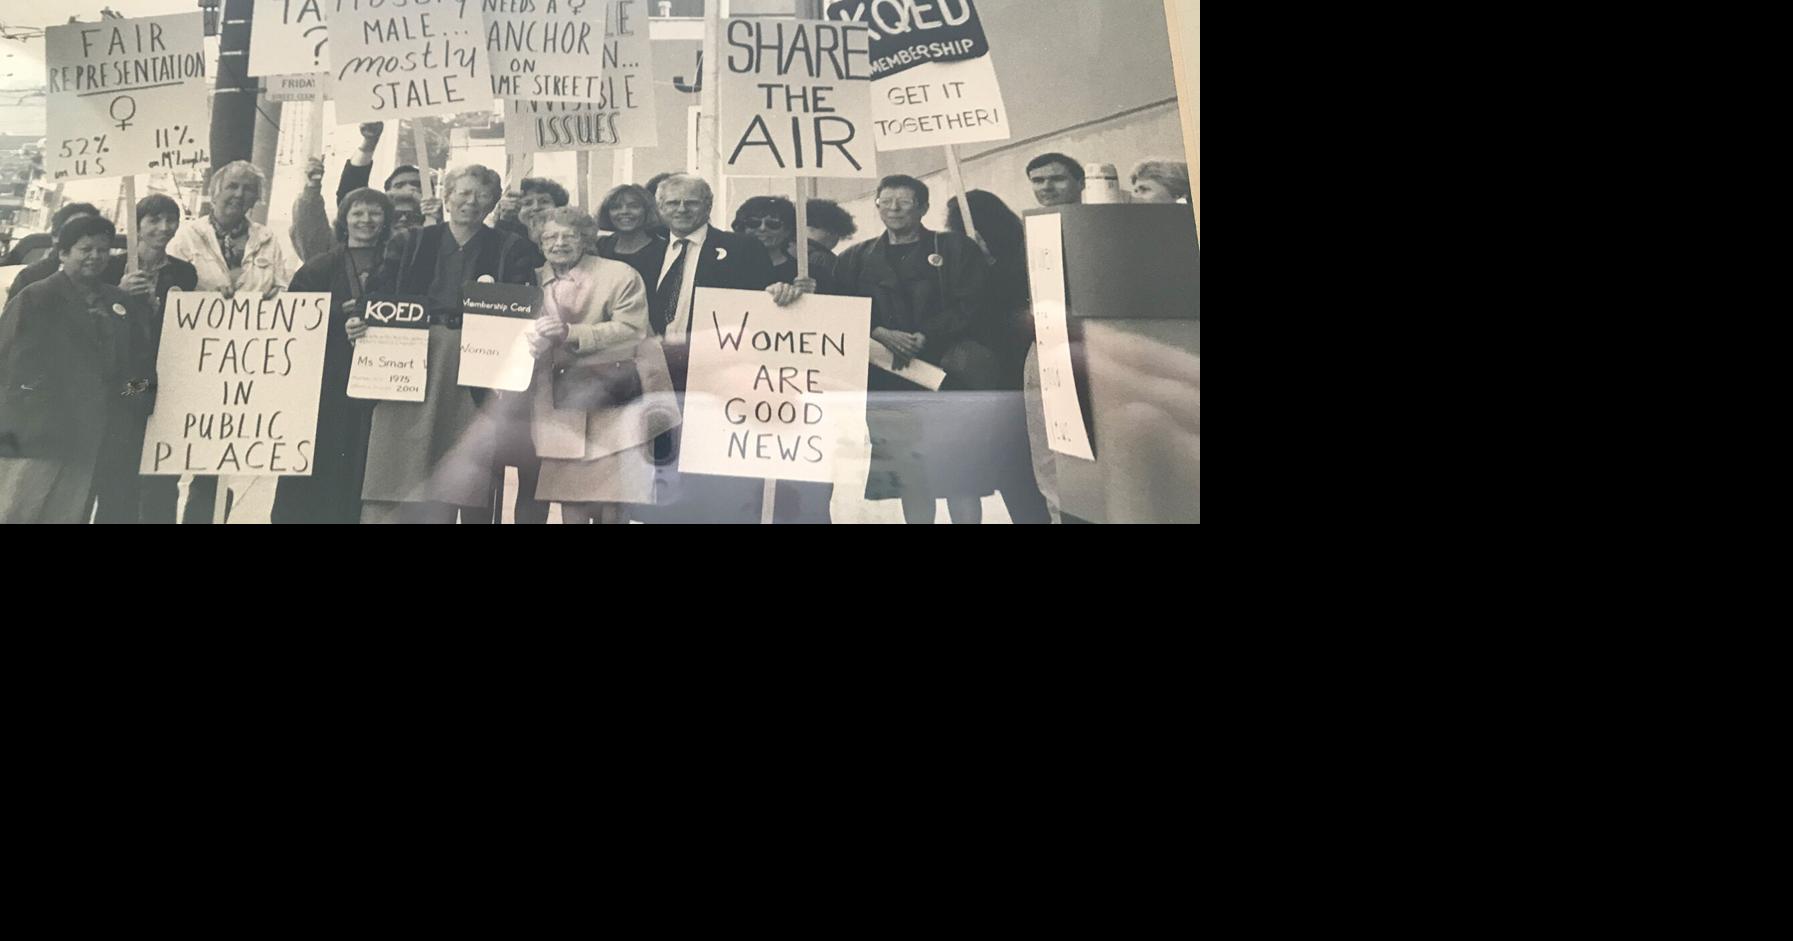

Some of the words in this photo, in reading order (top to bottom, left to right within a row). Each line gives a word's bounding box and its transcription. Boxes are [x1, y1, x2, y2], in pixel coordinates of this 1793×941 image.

[81, 22, 166, 57] FAIR
[363, 12, 469, 45] MALE...
[486, 20, 591, 55] ANCHOR
[338, 40, 477, 81] mostly
[510, 58, 536, 73] ON
[727, 19, 870, 81] SHARE
[869, 38, 974, 75] MEMBERSHIP
[49, 51, 205, 93] REPRESENTATION
[532, 74, 599, 98] STREET
[371, 75, 465, 111] STALE
[757, 83, 836, 113] THE
[887, 84, 931, 106] GET
[942, 81, 966, 100] IT
[156, 125, 195, 149] 11%
[535, 111, 621, 149] ISSUES
[874, 107, 1000, 136] TOGETHER!
[58, 134, 110, 159] 52%
[727, 114, 863, 172] AIR
[176, 297, 326, 333] WOMEN'S
[364, 300, 425, 324] KQED
[510, 302, 533, 314] Card
[198, 337, 298, 377] FACES
[357, 355, 374, 367] Ms
[378, 355, 415, 369] Smart
[223, 380, 254, 406] IN
[753, 364, 824, 394] ARE
[183, 410, 284, 440] PUBLIC
[725, 397, 823, 425] GOOD
[153, 440, 311, 473] PLACES
[727, 429, 824, 463] NEWS
